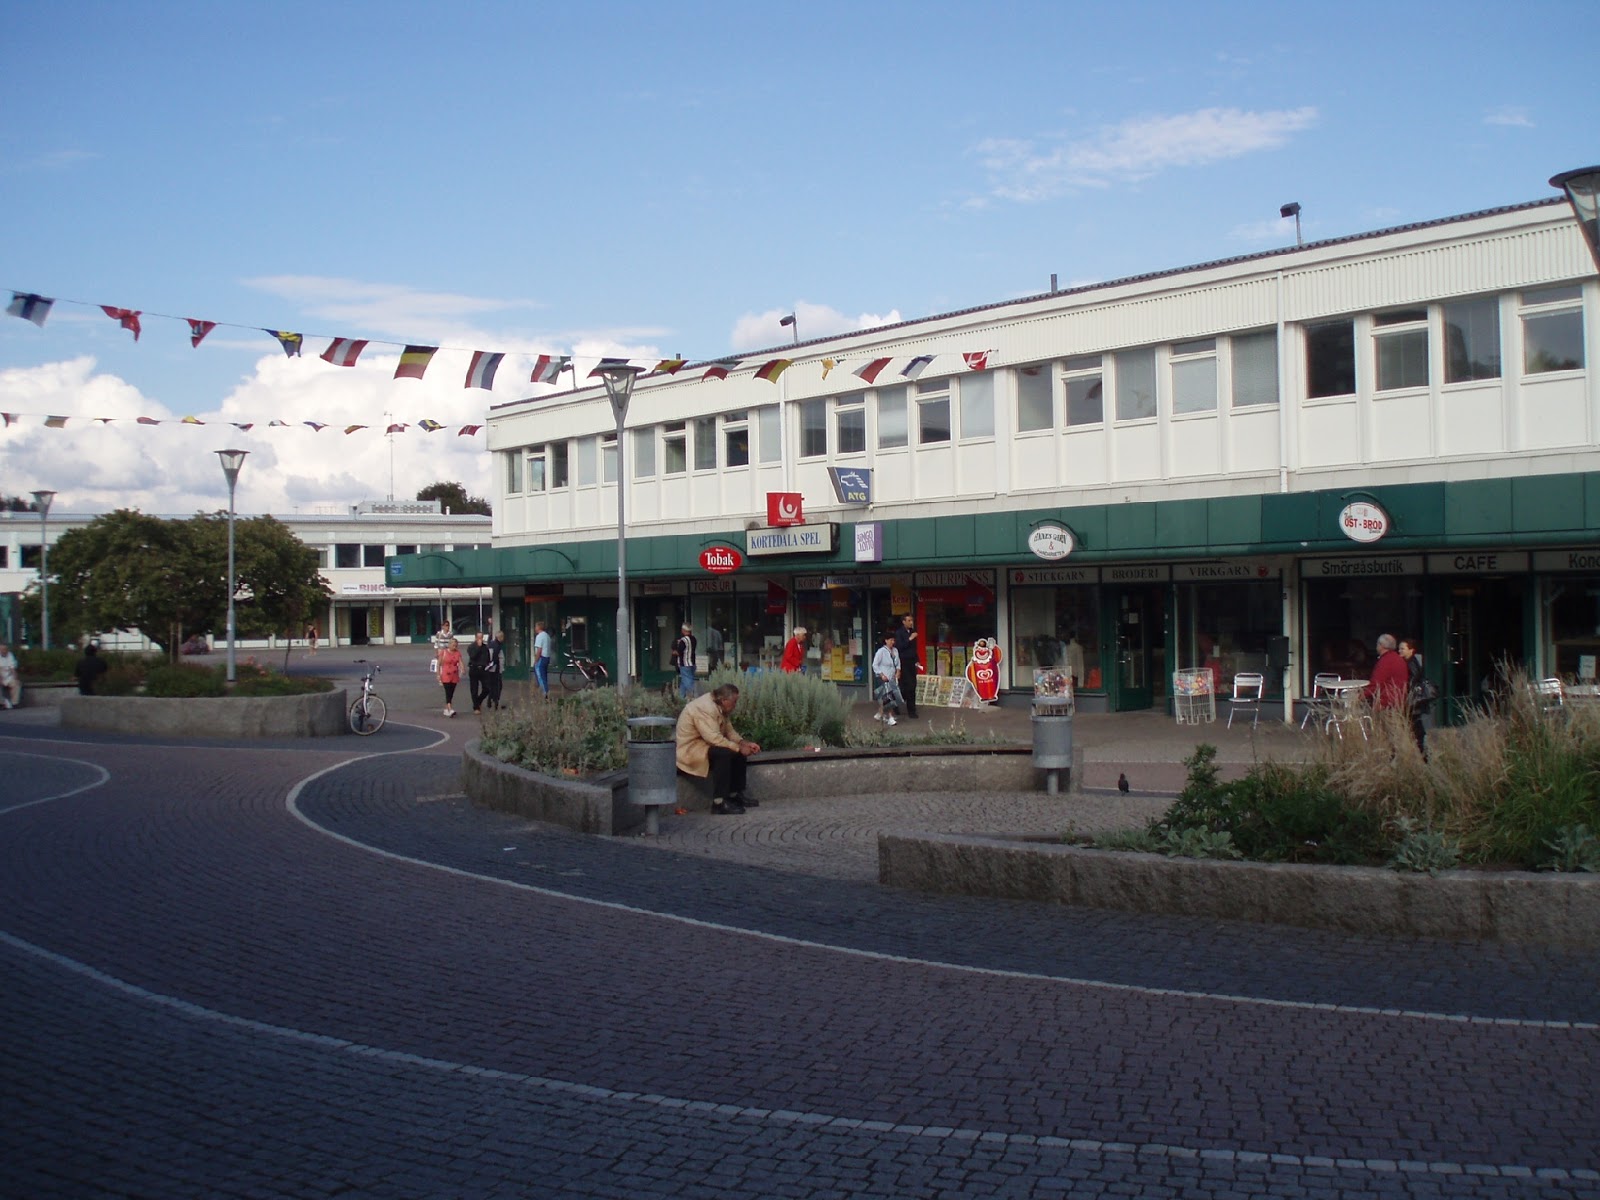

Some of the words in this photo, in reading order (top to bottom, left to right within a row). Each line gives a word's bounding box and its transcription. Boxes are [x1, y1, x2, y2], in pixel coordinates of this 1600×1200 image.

[848, 492, 866, 501] ATG
[751, 533, 798, 549] KORTEDALA
[800, 532, 821, 545] SPEL
[705, 553, 734, 566] Tobak
[1453, 556, 1497, 570] CAFE
[1188, 566, 1251, 577] VIRKGARN
[1321, 560, 1404, 575] Smörgåsbutik
[1028, 570, 1085, 581] STICKGARN
[1112, 569, 1159, 579] BRODERI
